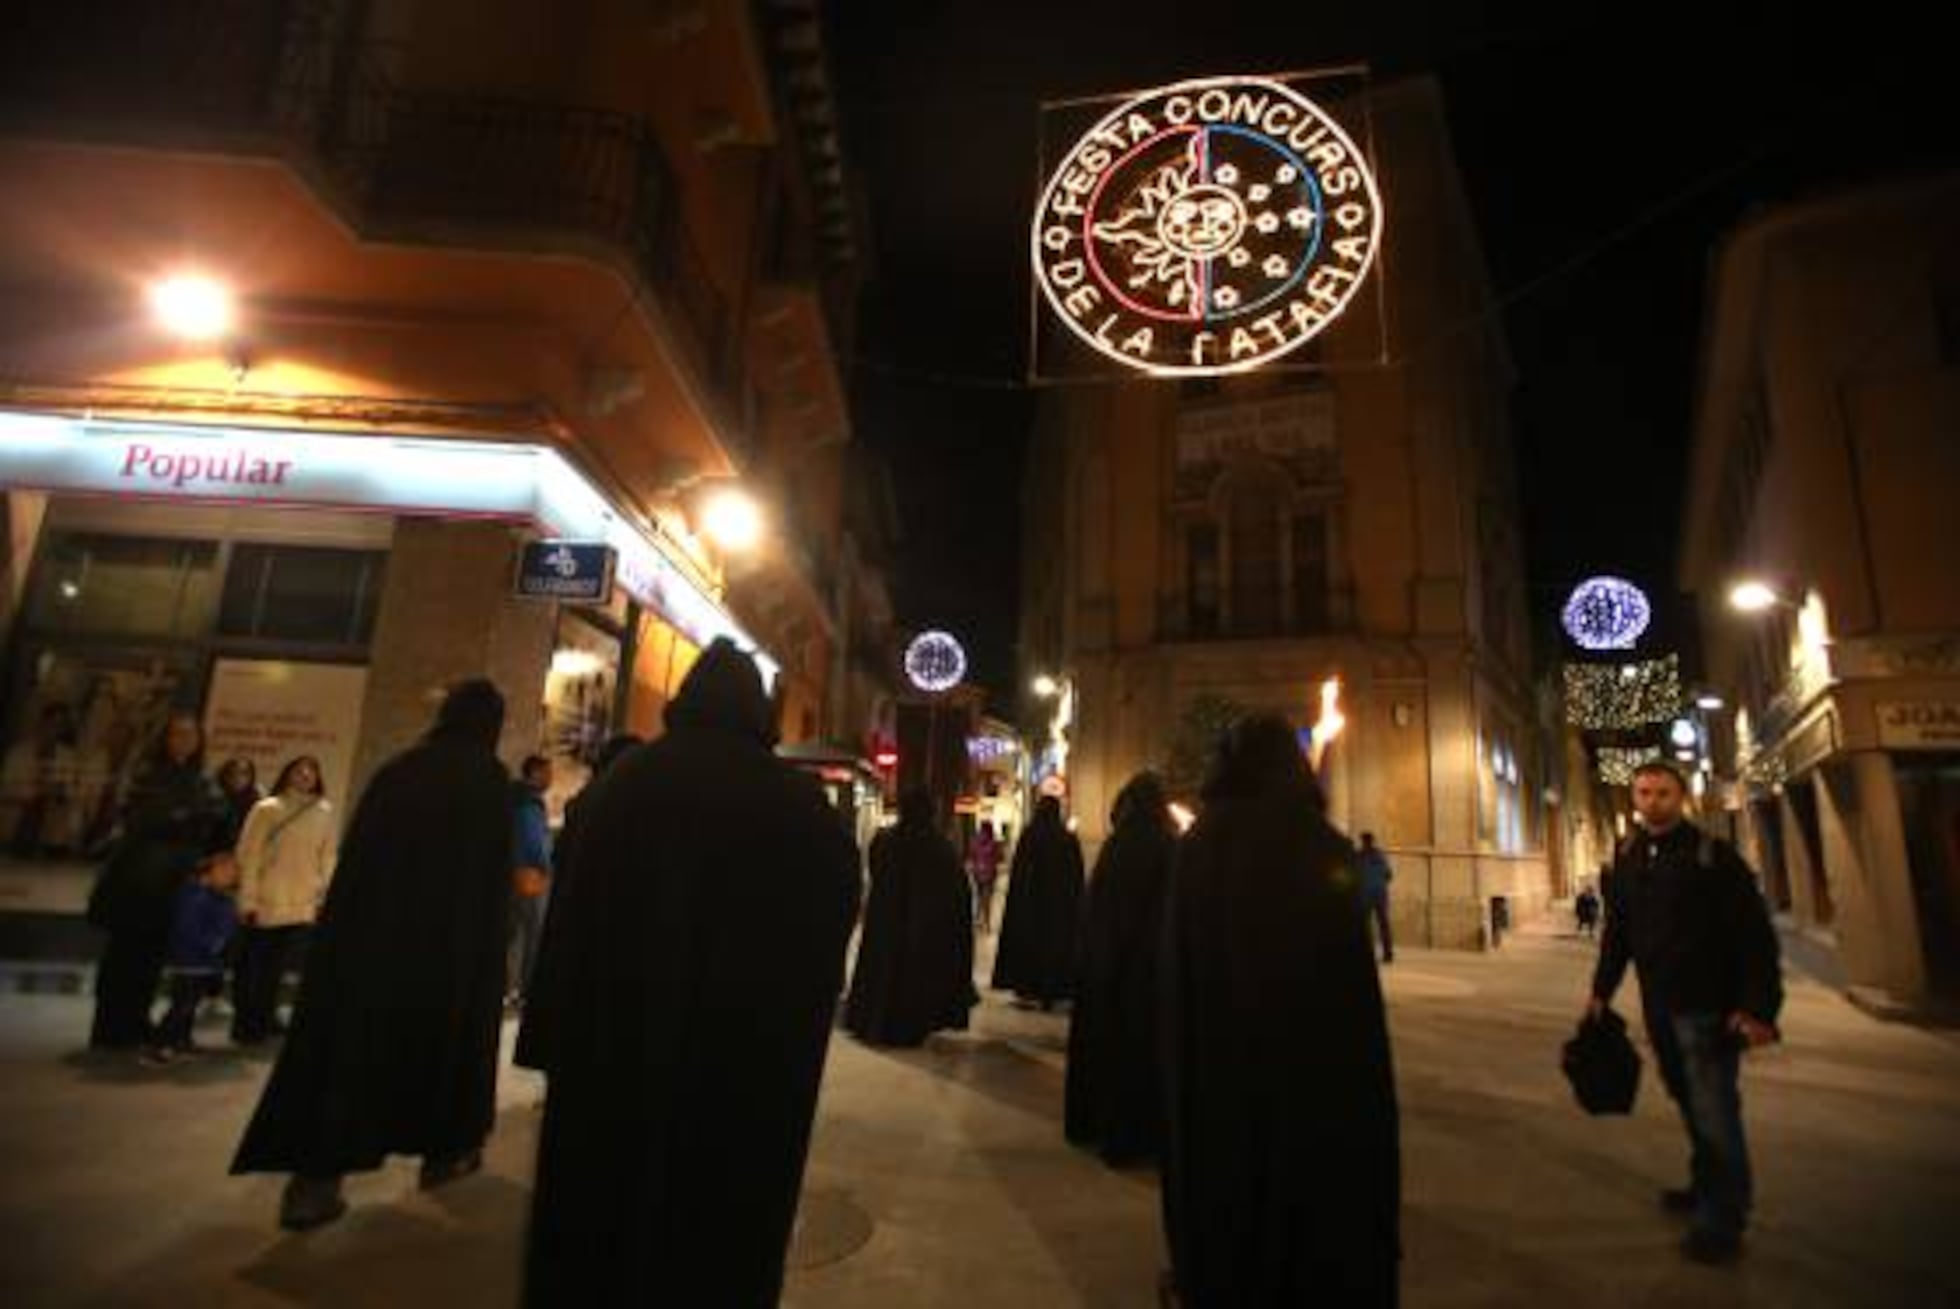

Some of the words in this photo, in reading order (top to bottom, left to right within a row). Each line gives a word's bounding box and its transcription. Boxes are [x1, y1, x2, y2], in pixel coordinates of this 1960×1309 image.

[1052, 113, 1155, 216] FESTA
[1164, 90, 1361, 195] CONCURS
[1052, 259, 1099, 317] DE
[1095, 314, 1154, 356] LA
[120, 444, 293, 487] Popular
